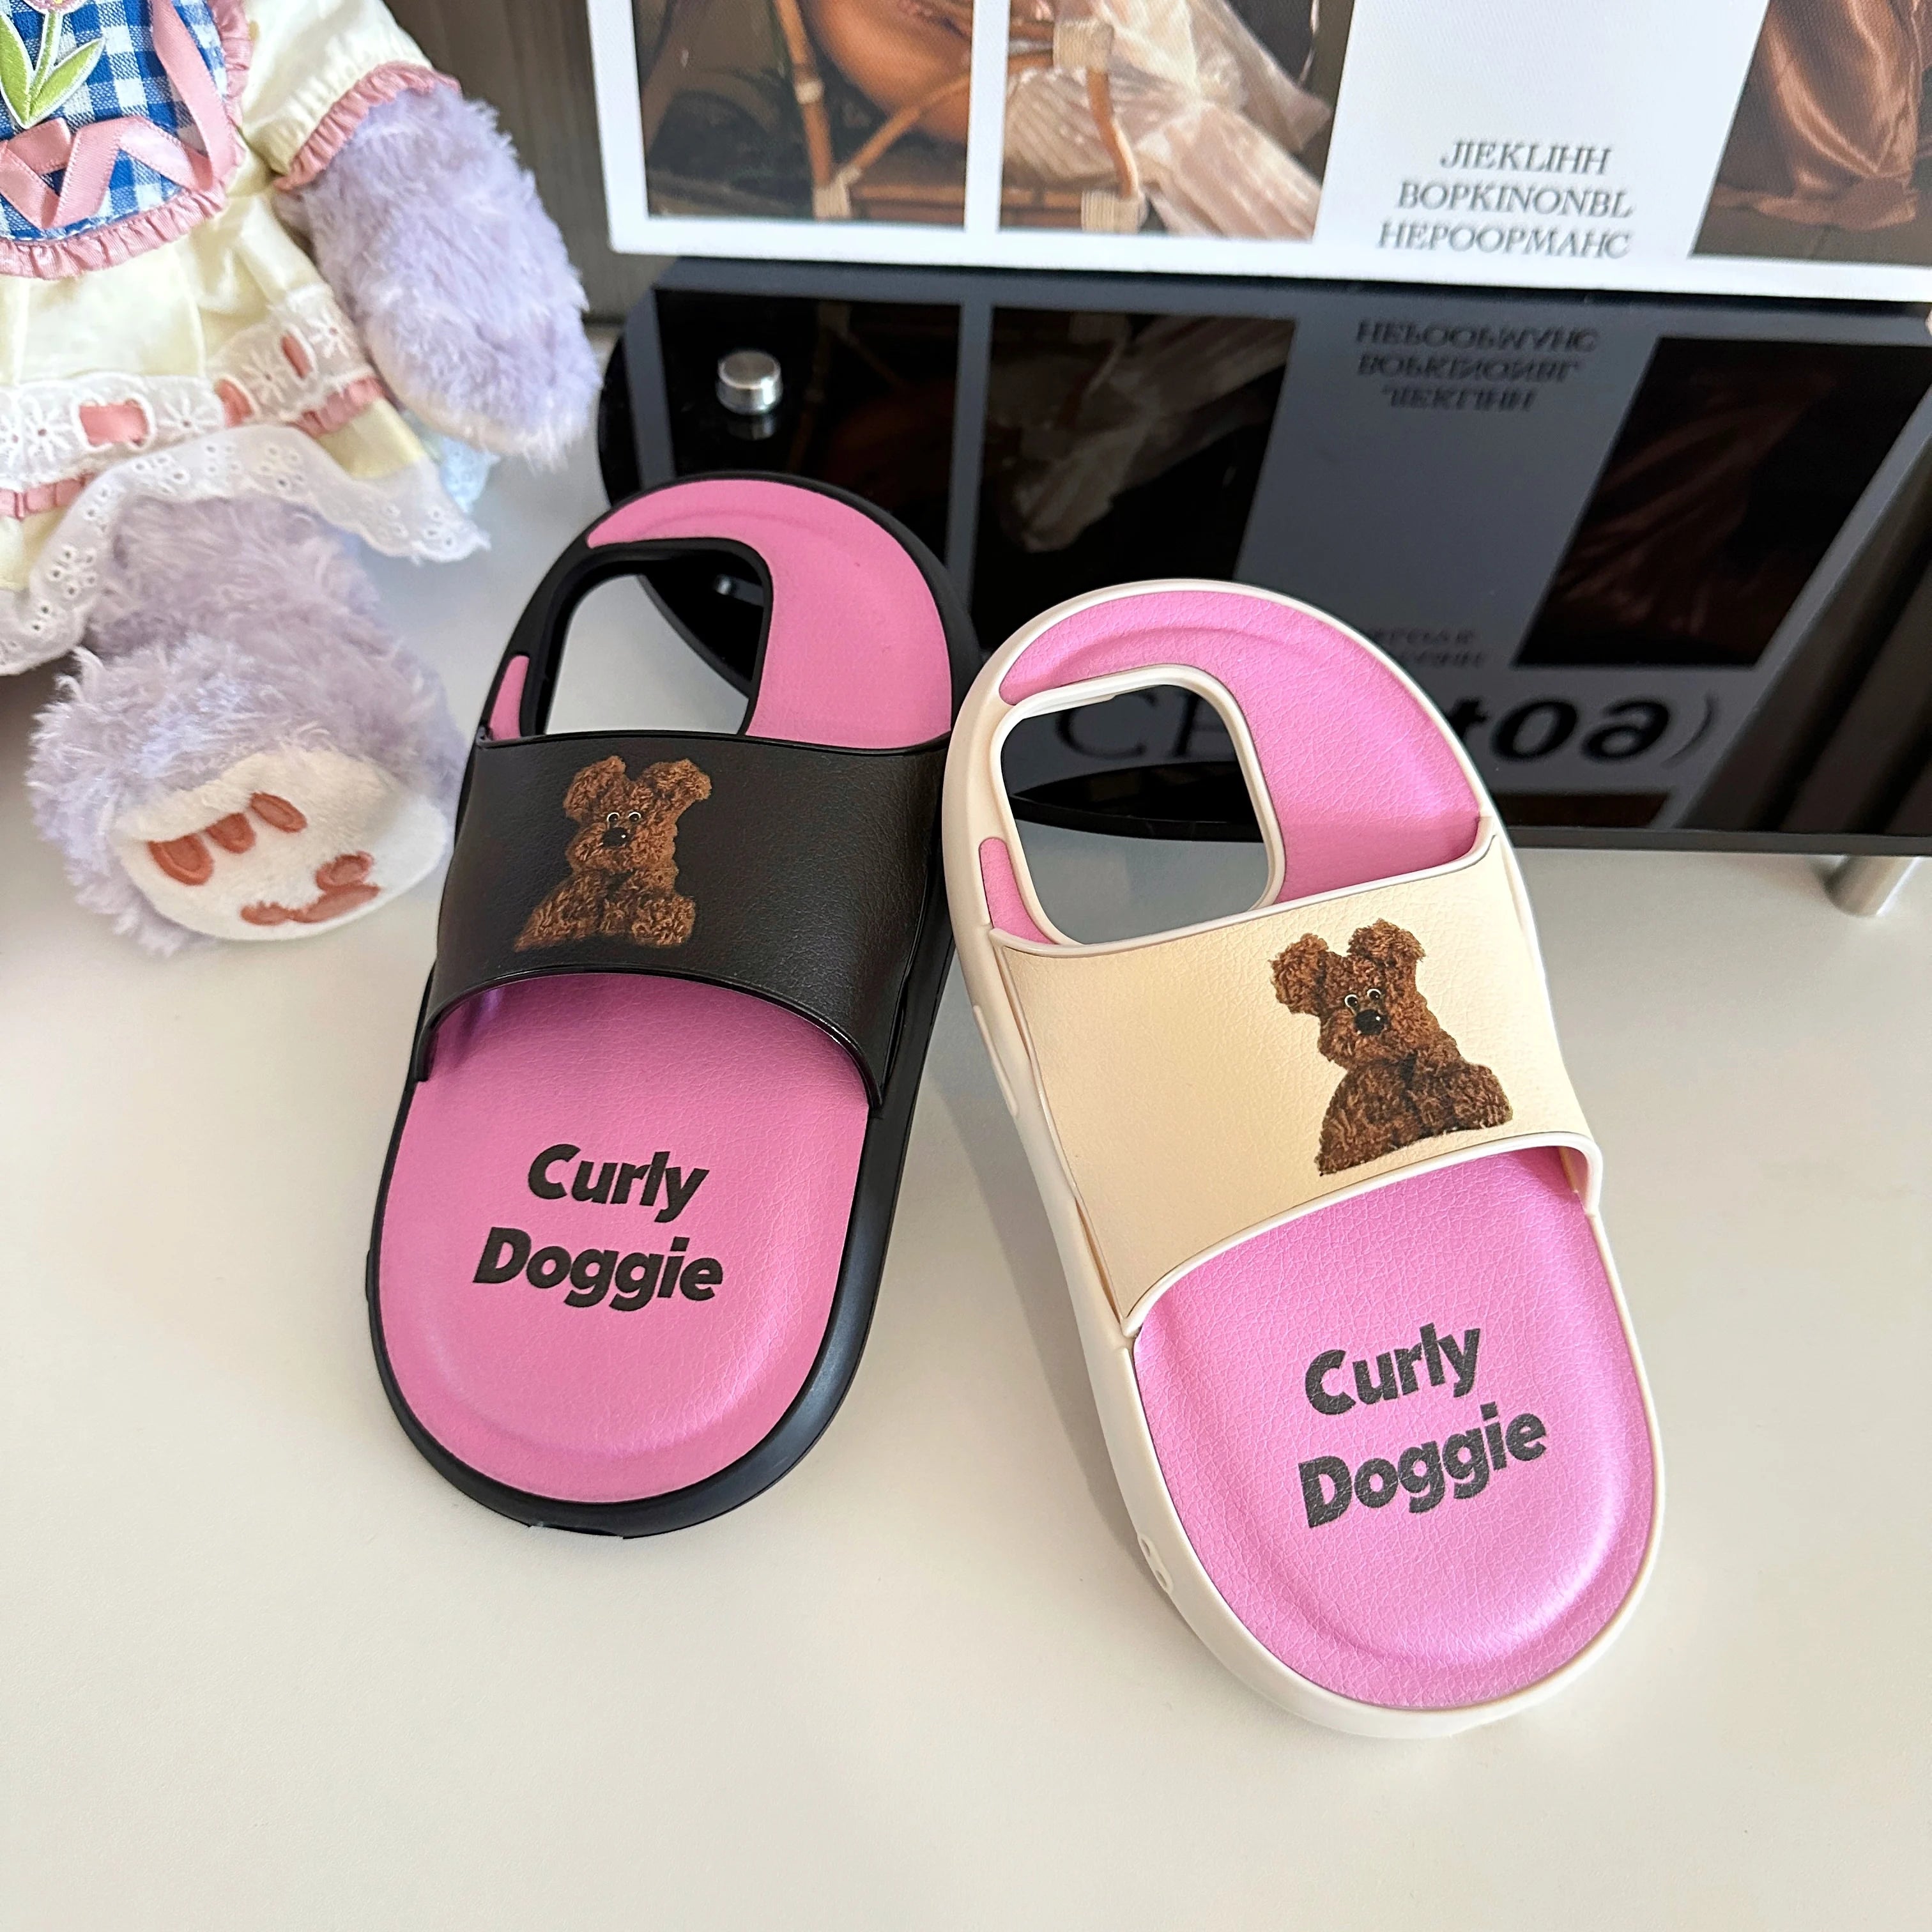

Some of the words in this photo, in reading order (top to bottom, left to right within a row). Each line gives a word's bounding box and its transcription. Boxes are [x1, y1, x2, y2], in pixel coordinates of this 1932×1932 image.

[528, 1143, 710, 1223] Curly
[472, 1226, 724, 1312] Doggie
[1305, 1322, 1481, 1416] Curly
[1298, 1401, 1547, 1528] Doggie
